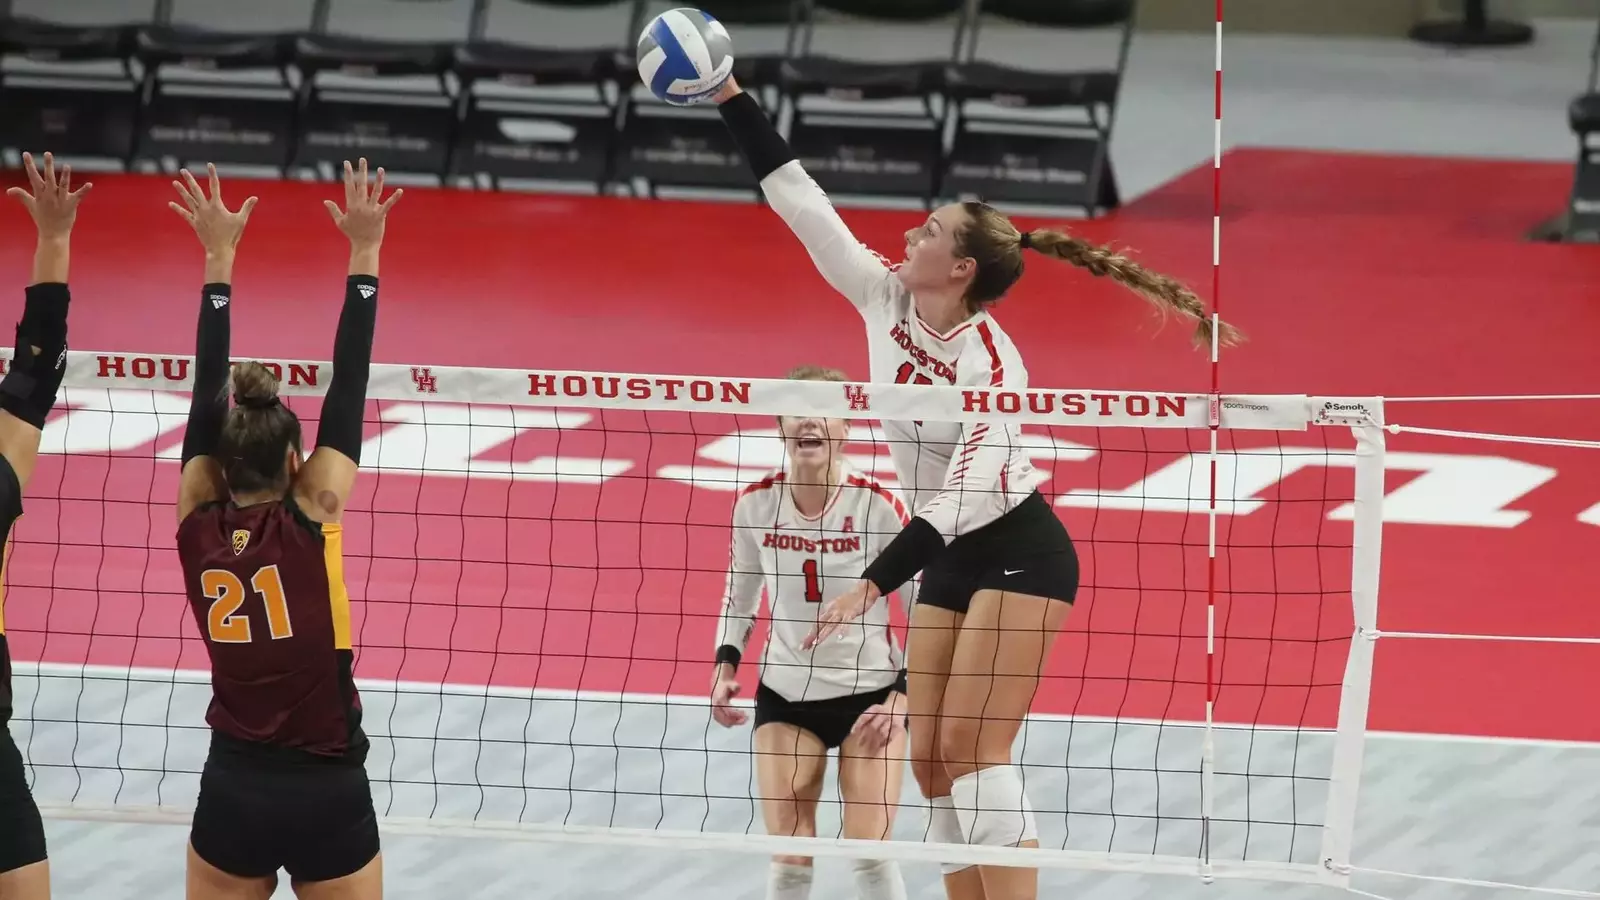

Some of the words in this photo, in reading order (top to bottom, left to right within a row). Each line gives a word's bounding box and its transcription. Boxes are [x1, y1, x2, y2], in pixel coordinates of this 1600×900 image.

[528, 374, 751, 404] HOUSTON
[962, 390, 1187, 417] HOUSTON
[1333, 403, 1364, 411] Senoh
[763, 533, 860, 553] HOUSTON
[803, 559, 823, 602] 1
[201, 564, 293, 643] 21
